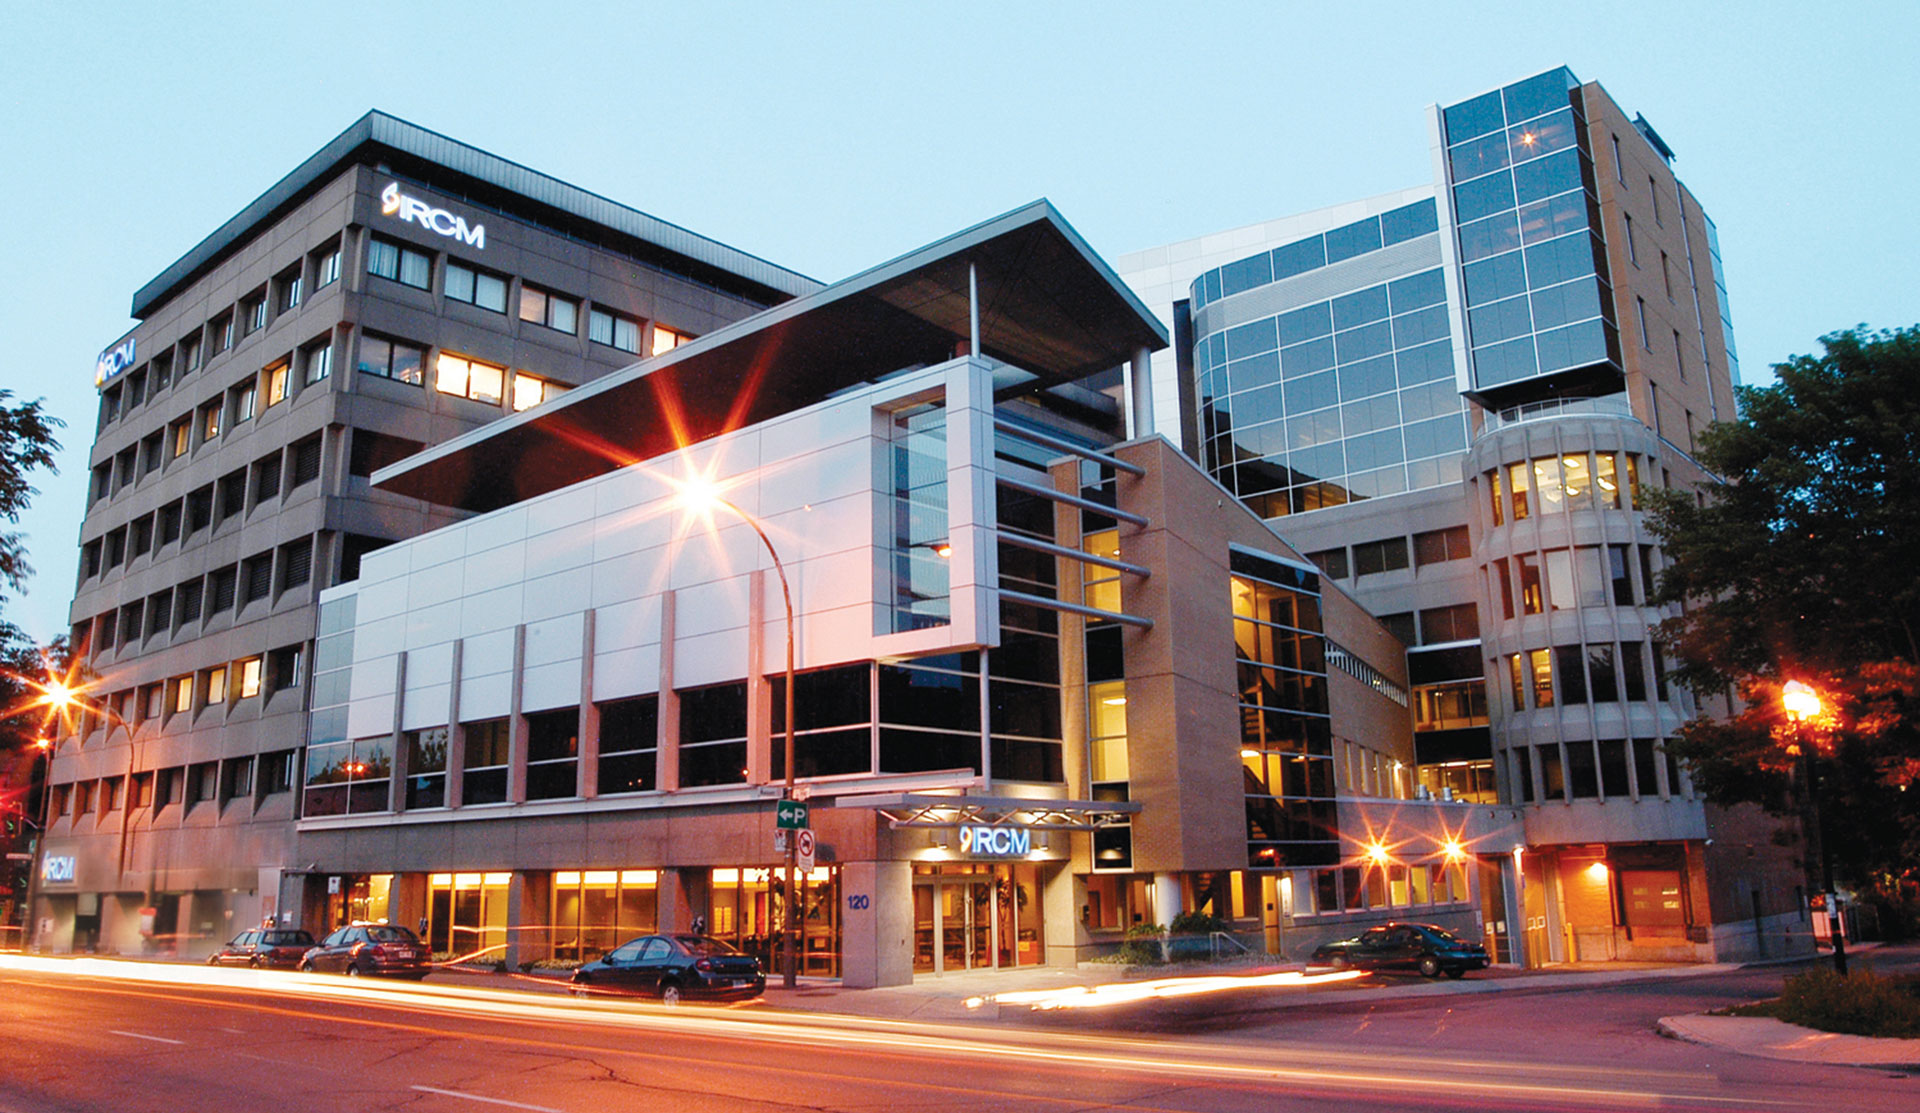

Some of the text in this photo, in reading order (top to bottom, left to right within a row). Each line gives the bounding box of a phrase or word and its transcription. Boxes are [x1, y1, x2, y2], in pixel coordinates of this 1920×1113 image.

[399, 194, 485, 249] IRCM
[794, 807, 806, 824] P
[971, 826, 1030, 855] IRCM
[848, 894, 870, 910] 120
